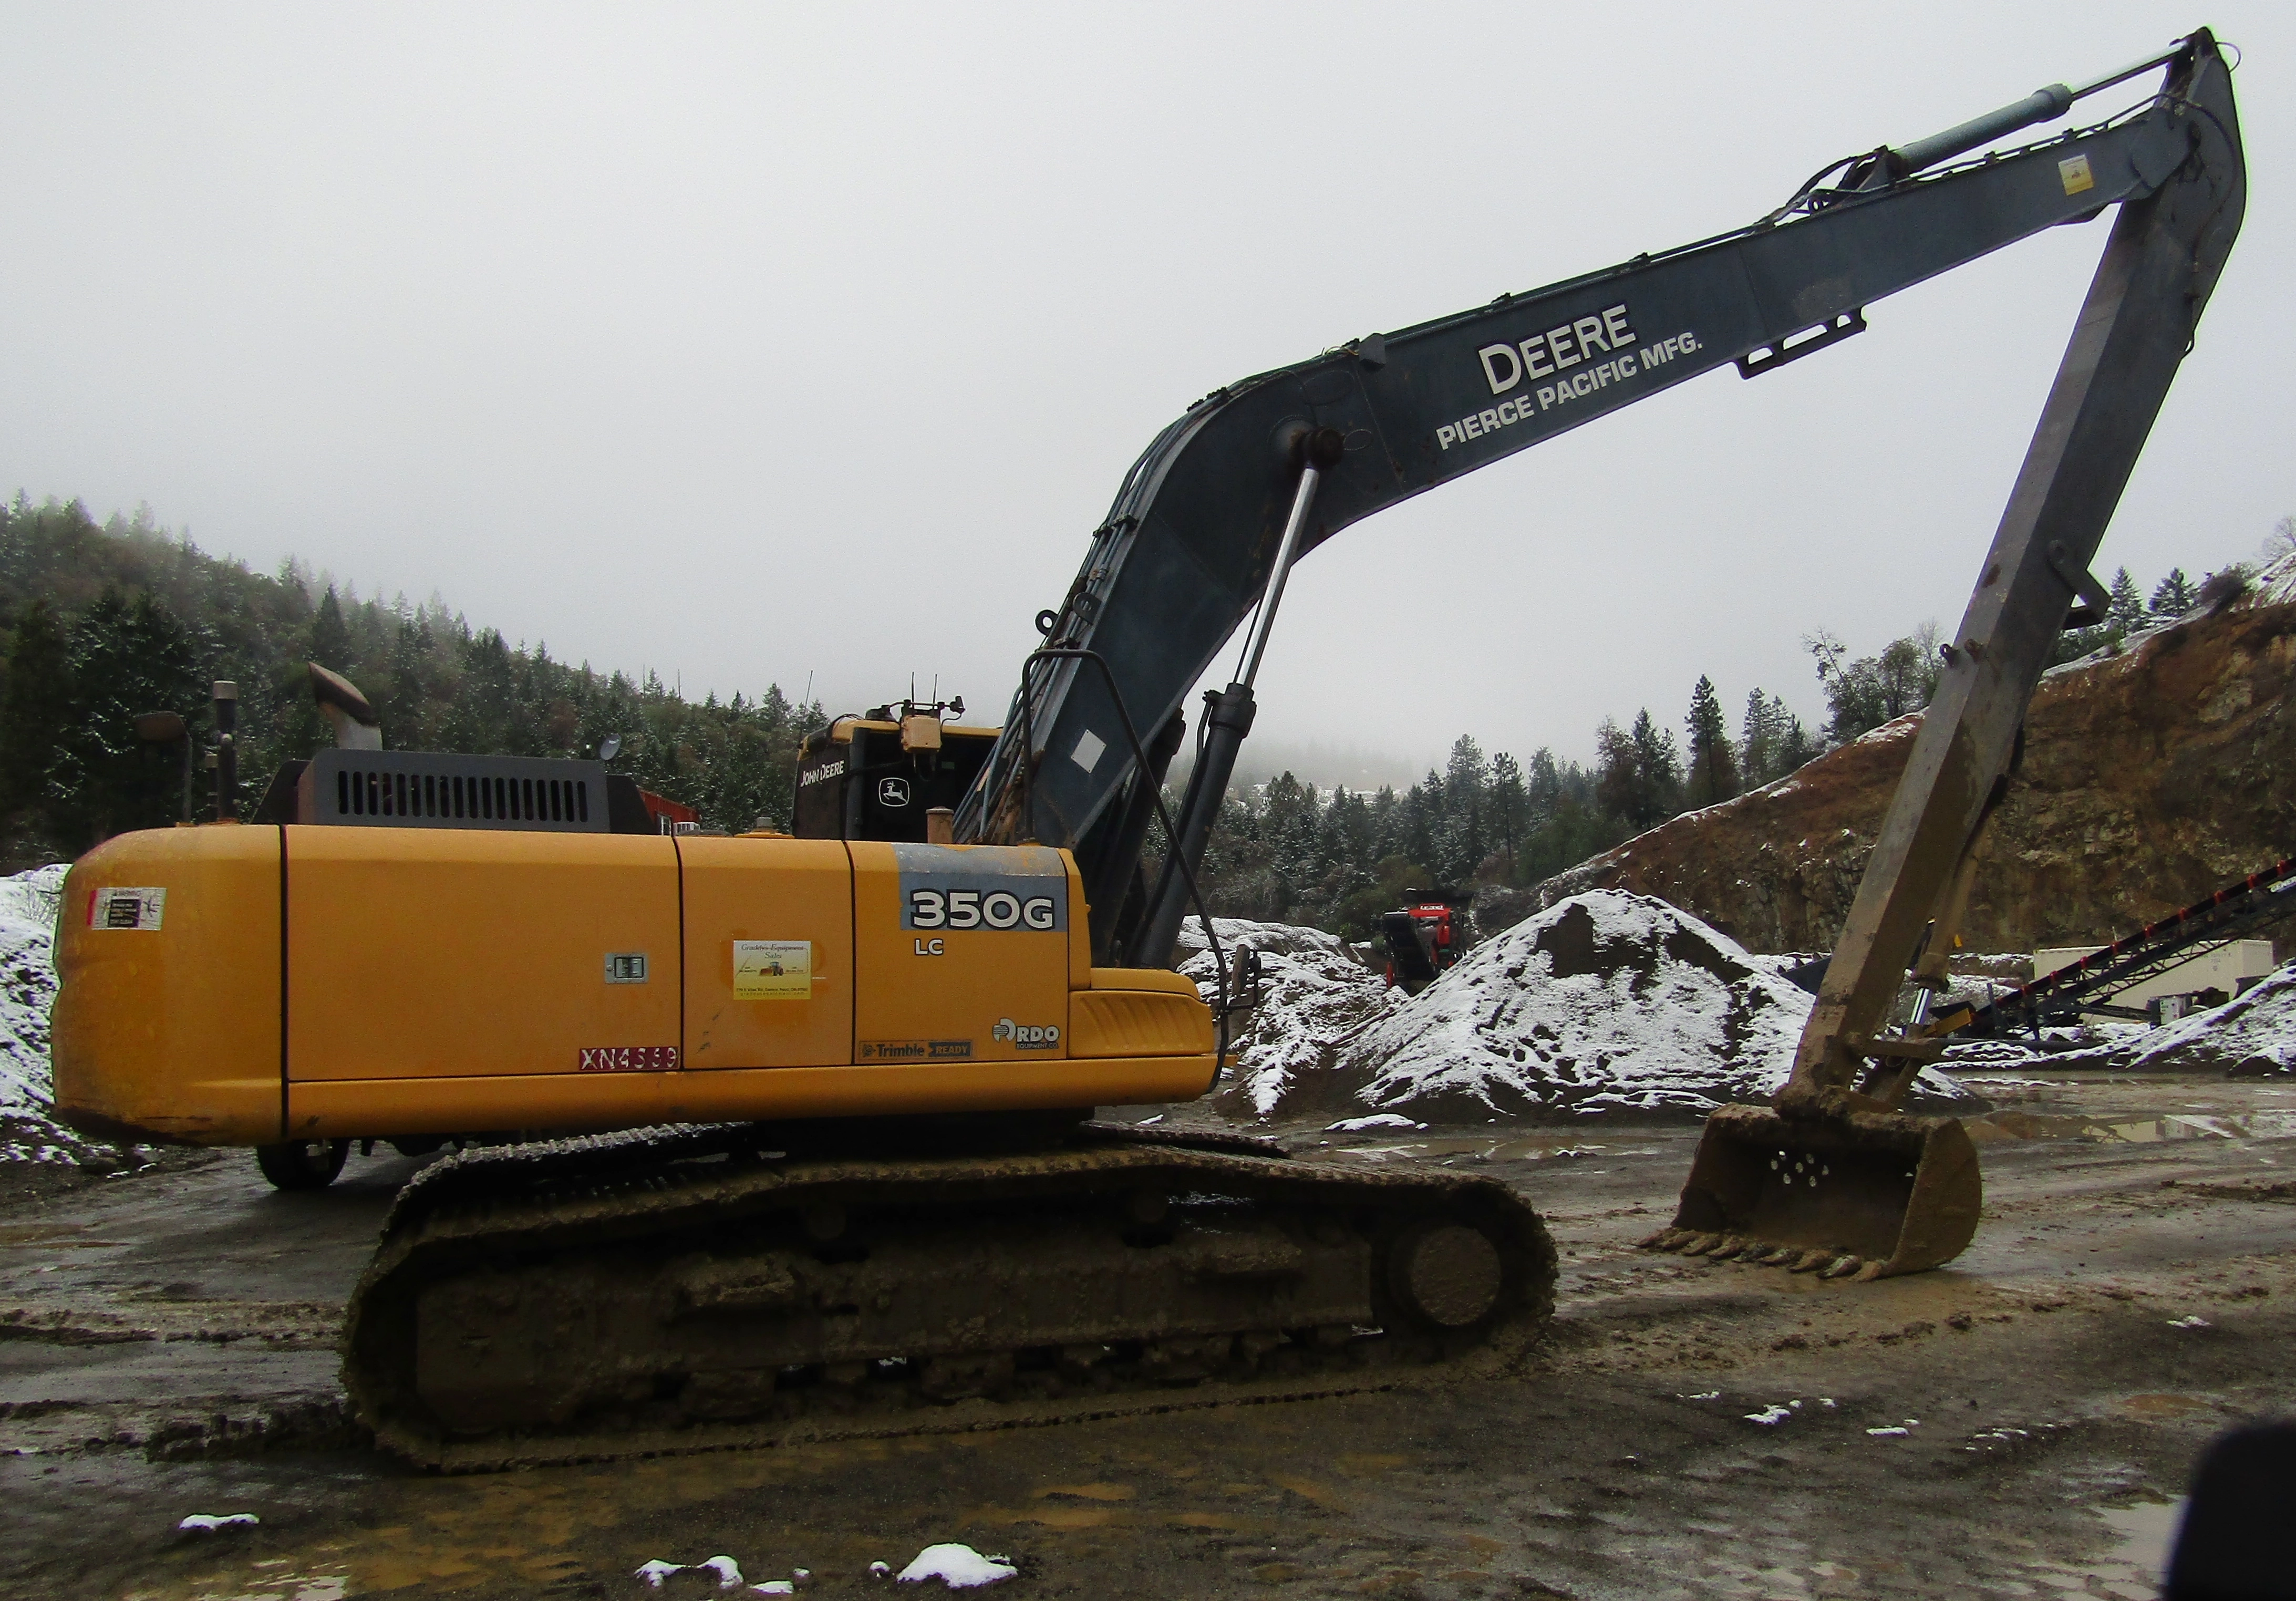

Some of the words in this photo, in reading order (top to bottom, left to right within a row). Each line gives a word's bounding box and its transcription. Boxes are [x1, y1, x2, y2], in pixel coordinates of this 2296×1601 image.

[1478, 304, 1637, 396] DEERE
[1436, 394, 1535, 451] PIERCE
[1537, 355, 1638, 411] PACIFIC
[1639, 332, 1703, 370] MFG.
[800, 769, 820, 787] JOHN
[820, 760, 845, 780] DEERE
[911, 889, 1055, 931] 350G
[915, 938, 944, 955] LC
[1017, 1025, 1059, 1042] RDO
[876, 1042, 924, 1058] Trimble
[935, 1045, 968, 1055] READY
